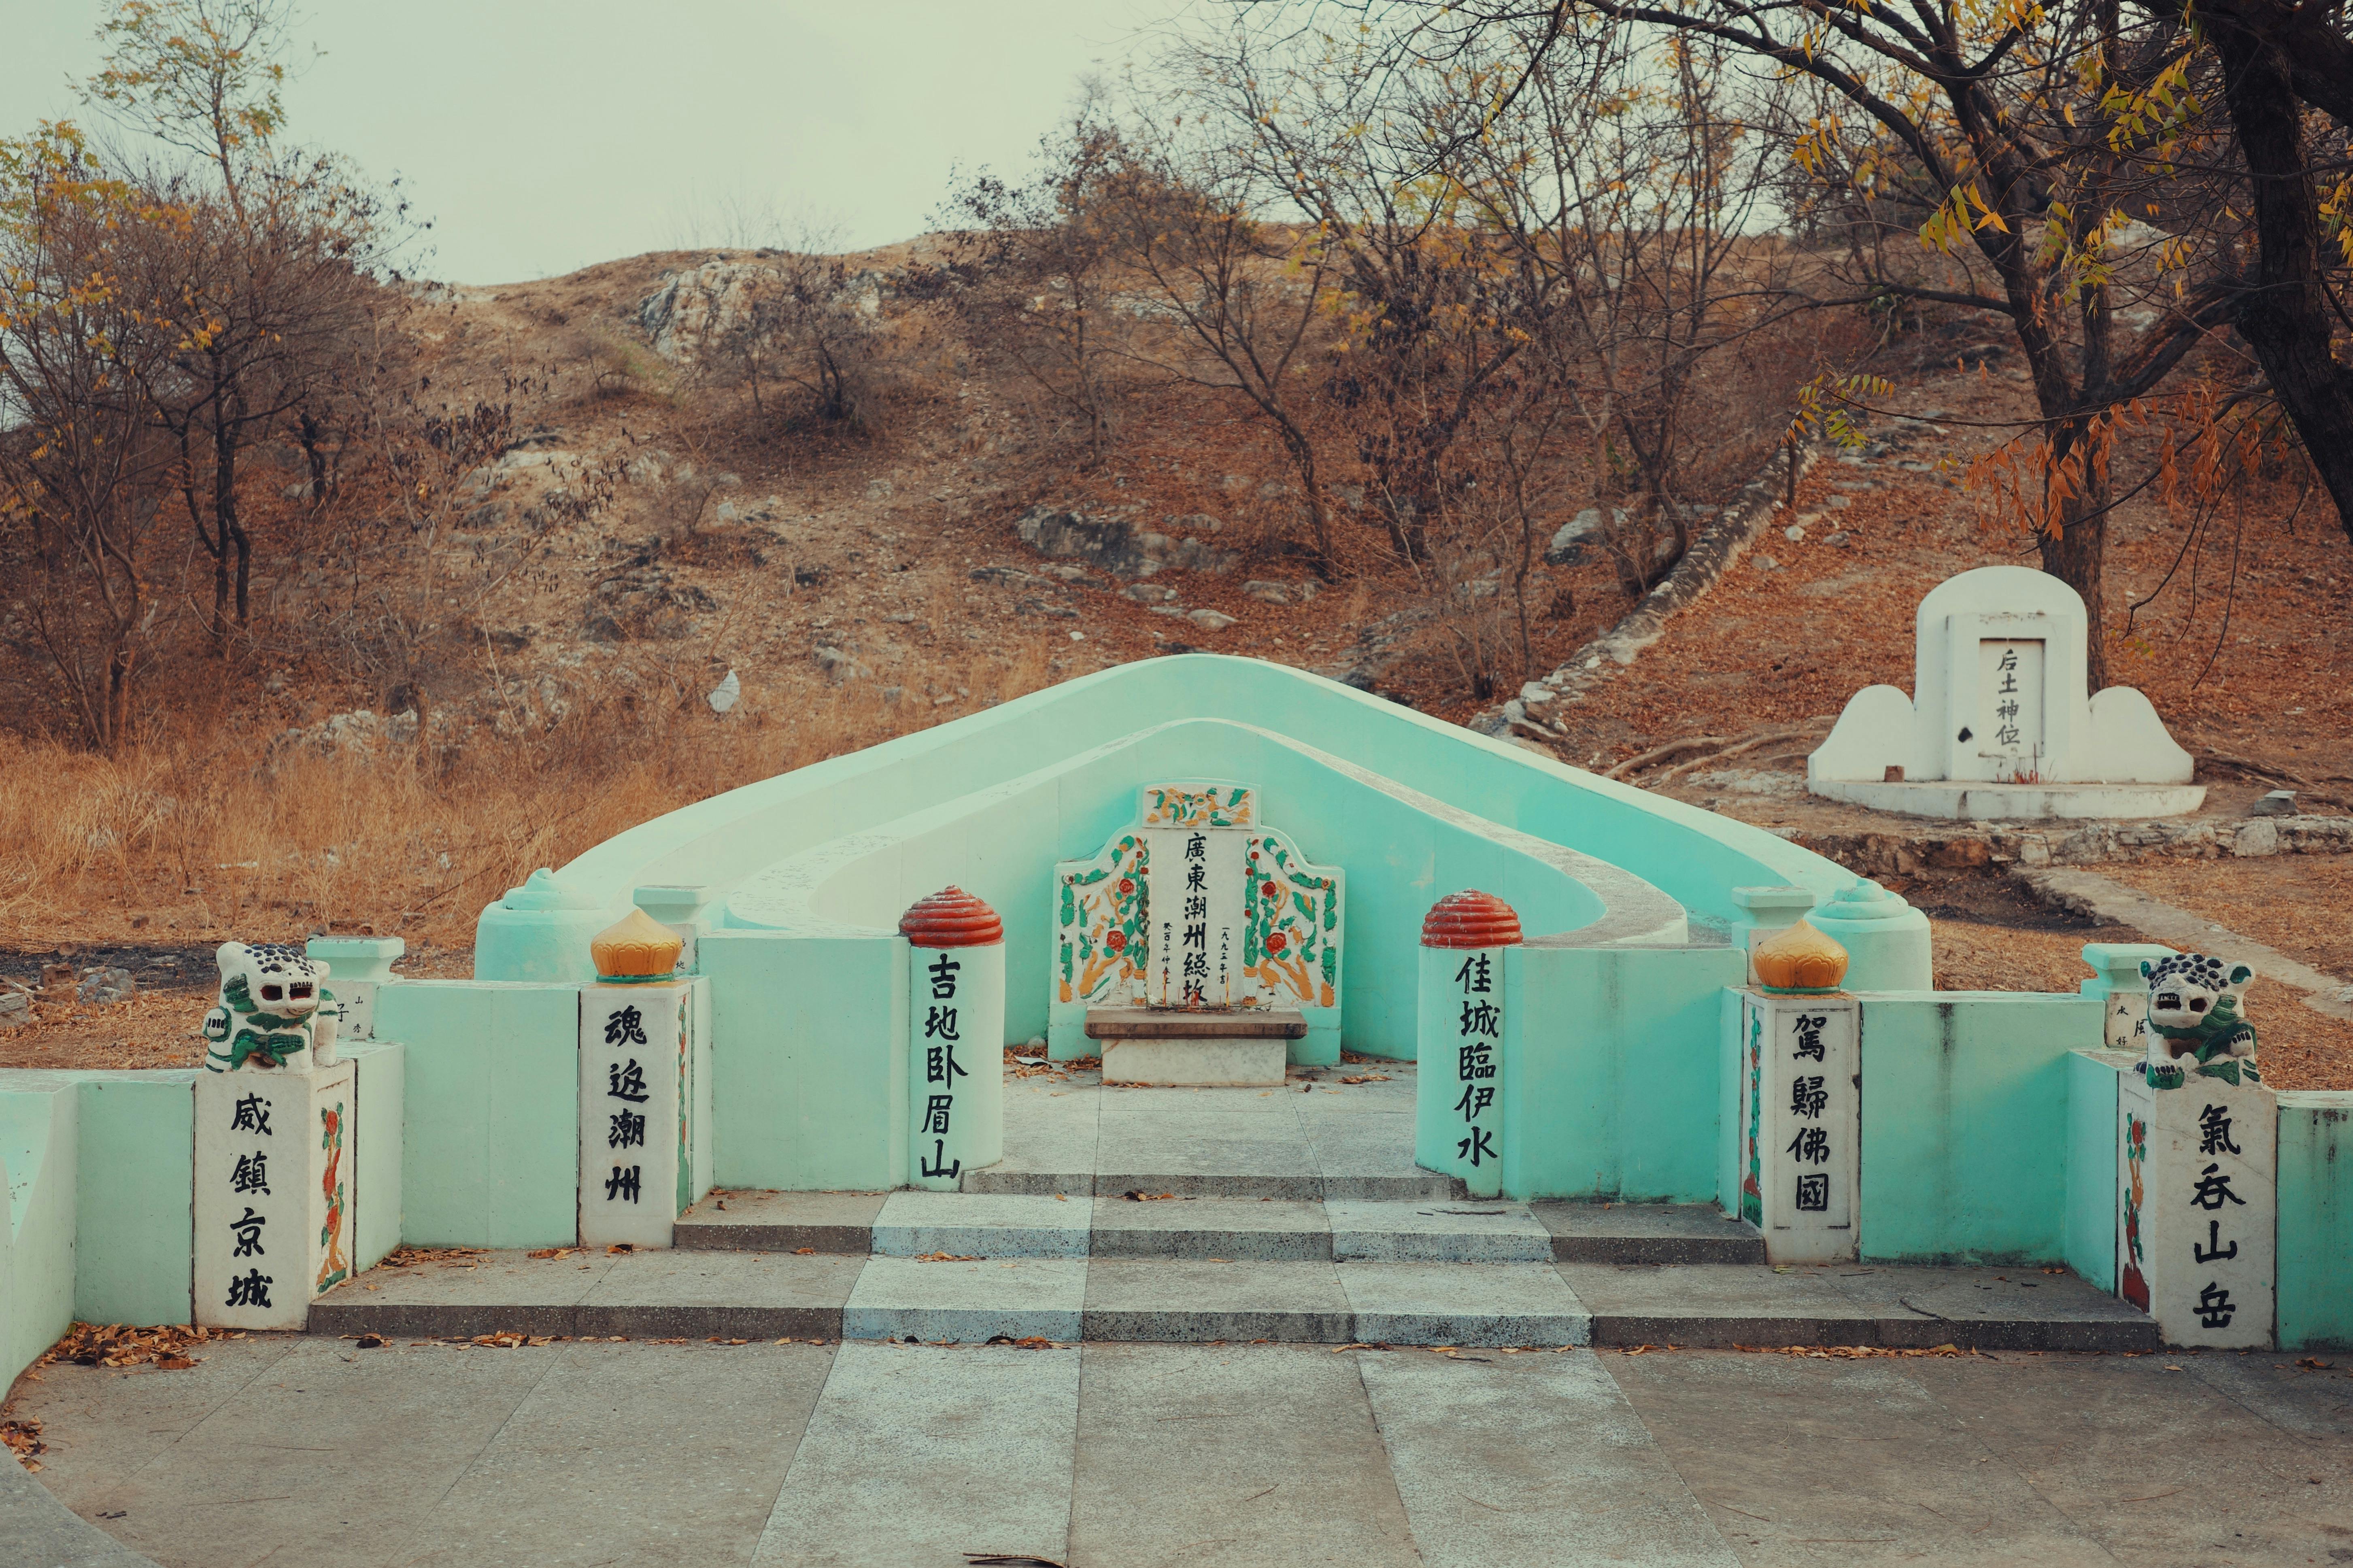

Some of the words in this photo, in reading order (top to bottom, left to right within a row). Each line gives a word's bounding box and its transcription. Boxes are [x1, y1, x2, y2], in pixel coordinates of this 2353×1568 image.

[1995, 648, 2020, 746] 后土神位
[1454, 953, 1500, 1167] 佳城臨伊水
[1786, 1014, 1830, 1211] 駕歸佛國
[225, 1092, 273, 1308] 威鎮京城
